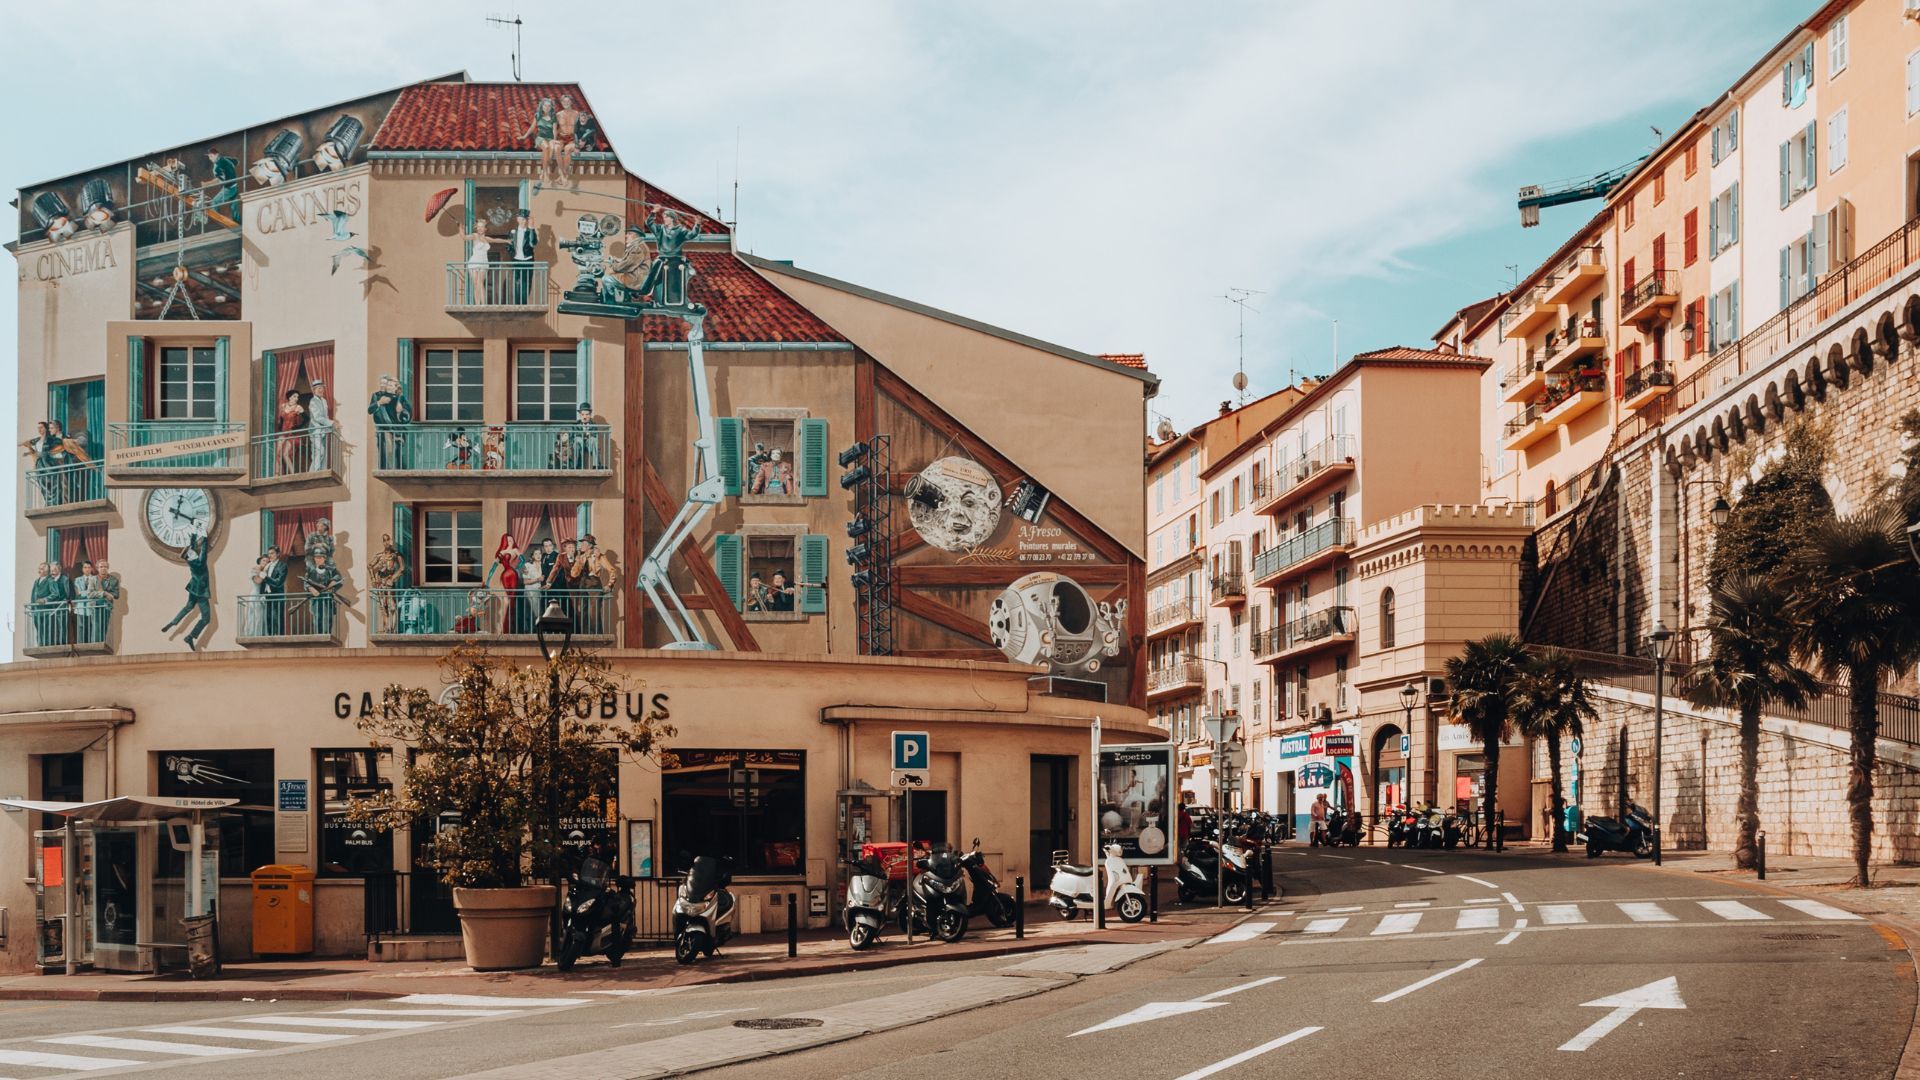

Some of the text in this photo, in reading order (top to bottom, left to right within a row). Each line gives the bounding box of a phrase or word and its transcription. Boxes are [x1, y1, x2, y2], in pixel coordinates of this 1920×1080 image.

[256, 181, 362, 235] CANNES
[36, 237, 117, 282] CINEMA
[143, 447, 162, 456] FILM
[1019, 541, 1077, 550] Peintures murales
[903, 739, 919, 763] P
[1281, 738, 1307, 754] MISTRAL
[1402, 738, 1408, 750] P
